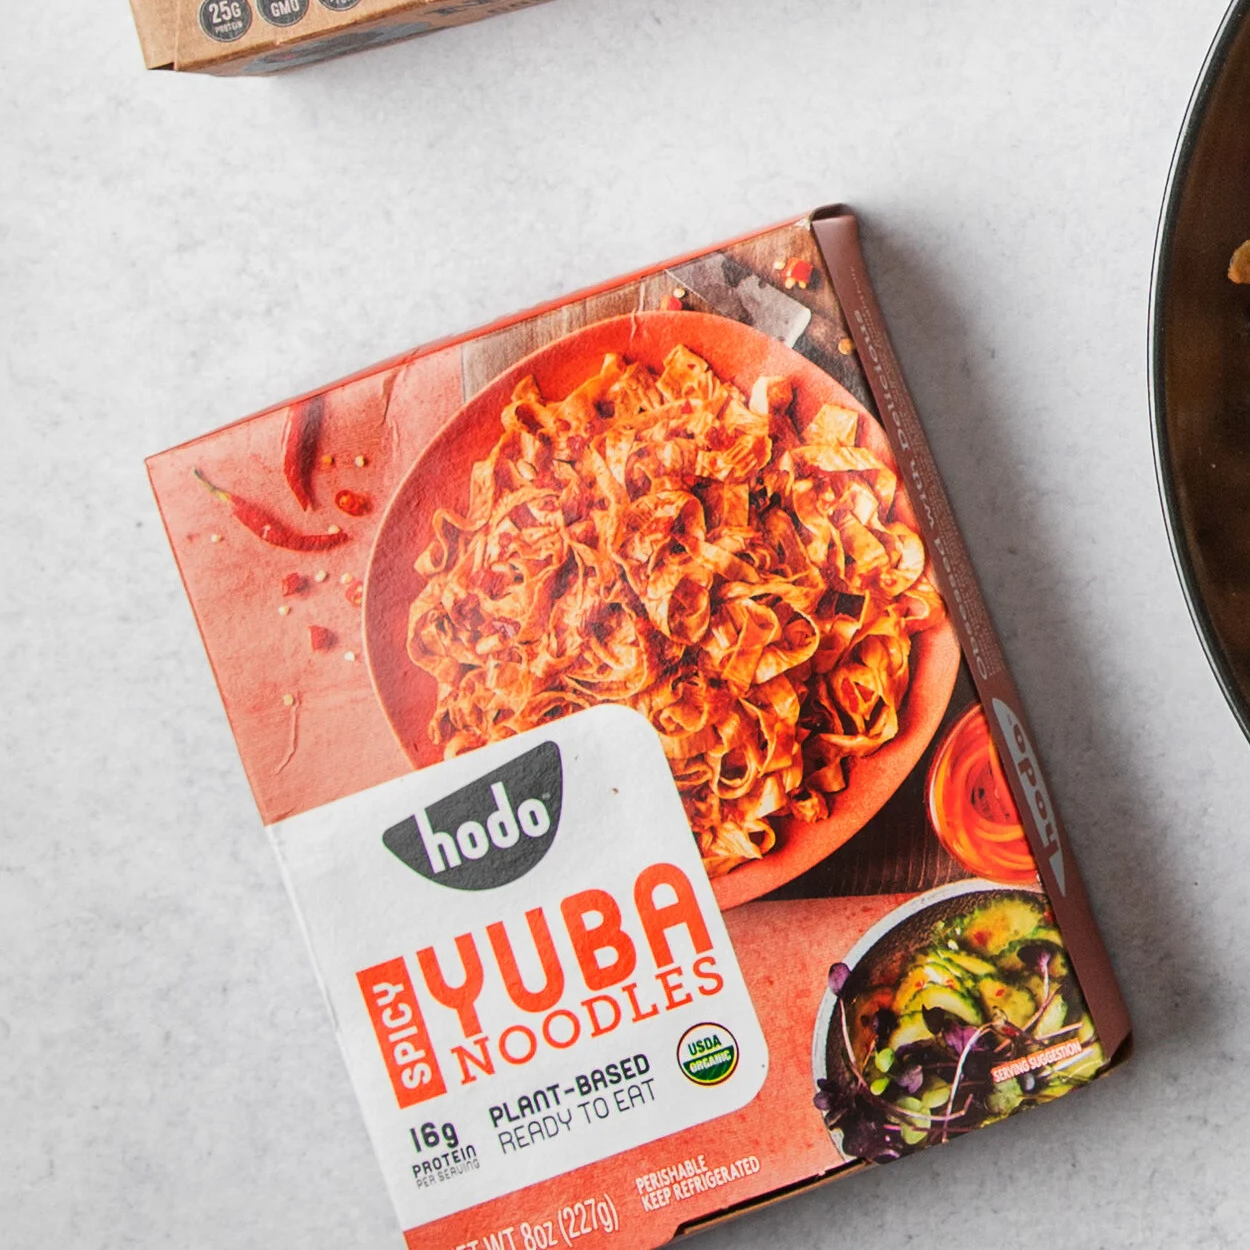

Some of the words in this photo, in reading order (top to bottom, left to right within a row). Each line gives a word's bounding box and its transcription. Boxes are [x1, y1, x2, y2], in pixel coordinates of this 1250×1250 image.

[208, 0, 242, 23] 25G
[214, 20, 243, 34] PROTEIN
[854, 309, 910, 451] Delicious
[910, 459, 936, 529] with
[933, 538, 988, 681] Obsessed
[1013, 724, 1059, 857] hodo
[414, 781, 551, 874] hodo
[416, 862, 714, 1039] YUBA
[373, 981, 432, 1090] SPICY
[451, 956, 724, 1086] NOODLES
[688, 1034, 722, 1056] USDA
[690, 1050, 732, 1073] ORGANIC
[993, 1061, 1029, 1082] SERVING
[1029, 1041, 1082, 1069] SUGGESTION
[488, 1053, 651, 1128] PLANT-BASED
[498, 1109, 573, 1154] READY
[577, 1097, 610, 1125] TO
[613, 1078, 657, 1113] EAT
[410, 1122, 459, 1153] 16g
[412, 1145, 477, 1178] PROTEIN
[416, 1174, 437, 1189] PER
[437, 1159, 480, 1182] SERVING
[635, 1155, 709, 1194] PERISHABLE
[641, 1188, 672, 1212] KEEP
[673, 1155, 761, 1202] REFRIGERATED
[519, 1221, 557, 1250] 8oz
[557, 1193, 619, 1247] (227g)
